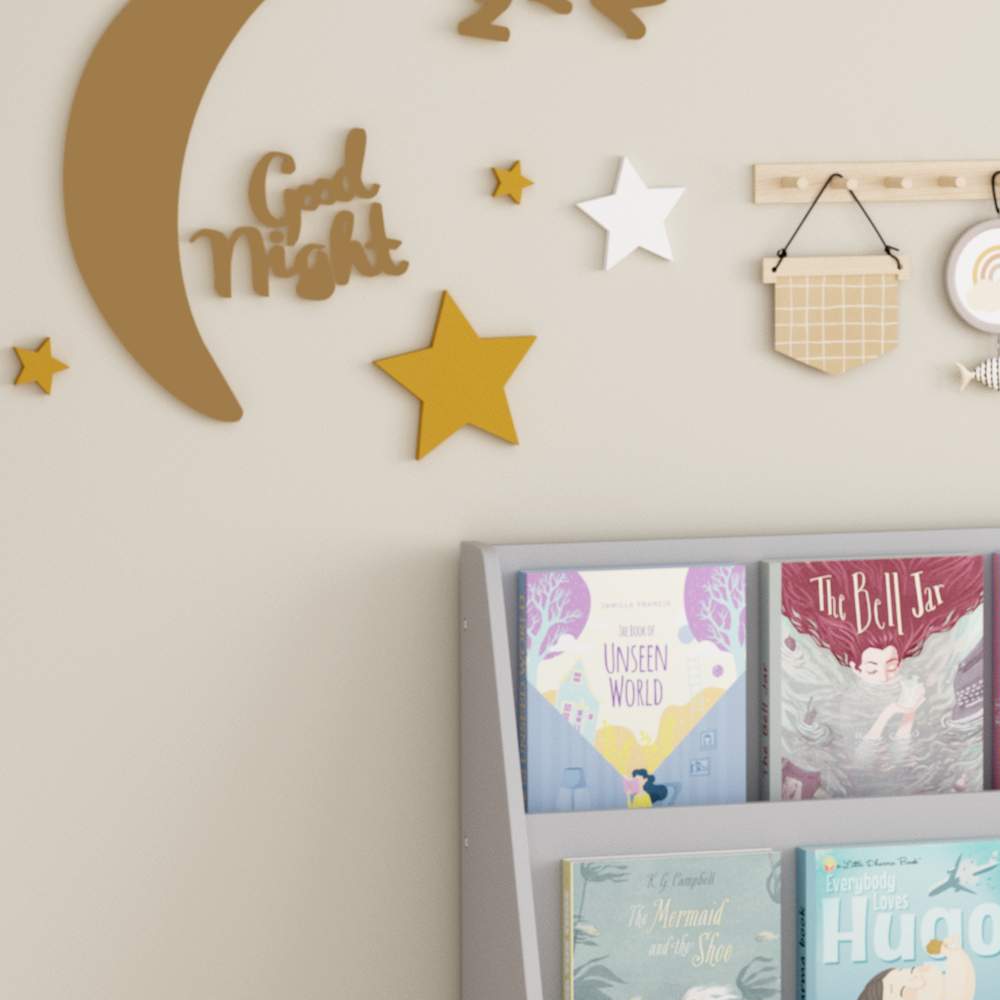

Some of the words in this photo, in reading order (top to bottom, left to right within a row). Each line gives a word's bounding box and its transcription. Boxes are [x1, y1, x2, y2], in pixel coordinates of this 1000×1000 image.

[248, 127, 381, 246] Good
[809, 574, 847, 621] The
[852, 571, 905, 636] Bell
[910, 570, 946, 619] Jar
[518, 594, 526, 676] WORLD
[603, 642, 668, 674] UNSEEN
[609, 675, 664, 708] WORLD
[671, 870, 717, 890] Campbell
[826, 871, 896, 896] Everybody
[628, 904, 648, 929] The
[645, 898, 730, 934] Mermaid
[873, 892, 909, 911] Loves
[648, 935, 674, 956] and
[691, 931, 733, 968] Shoe
